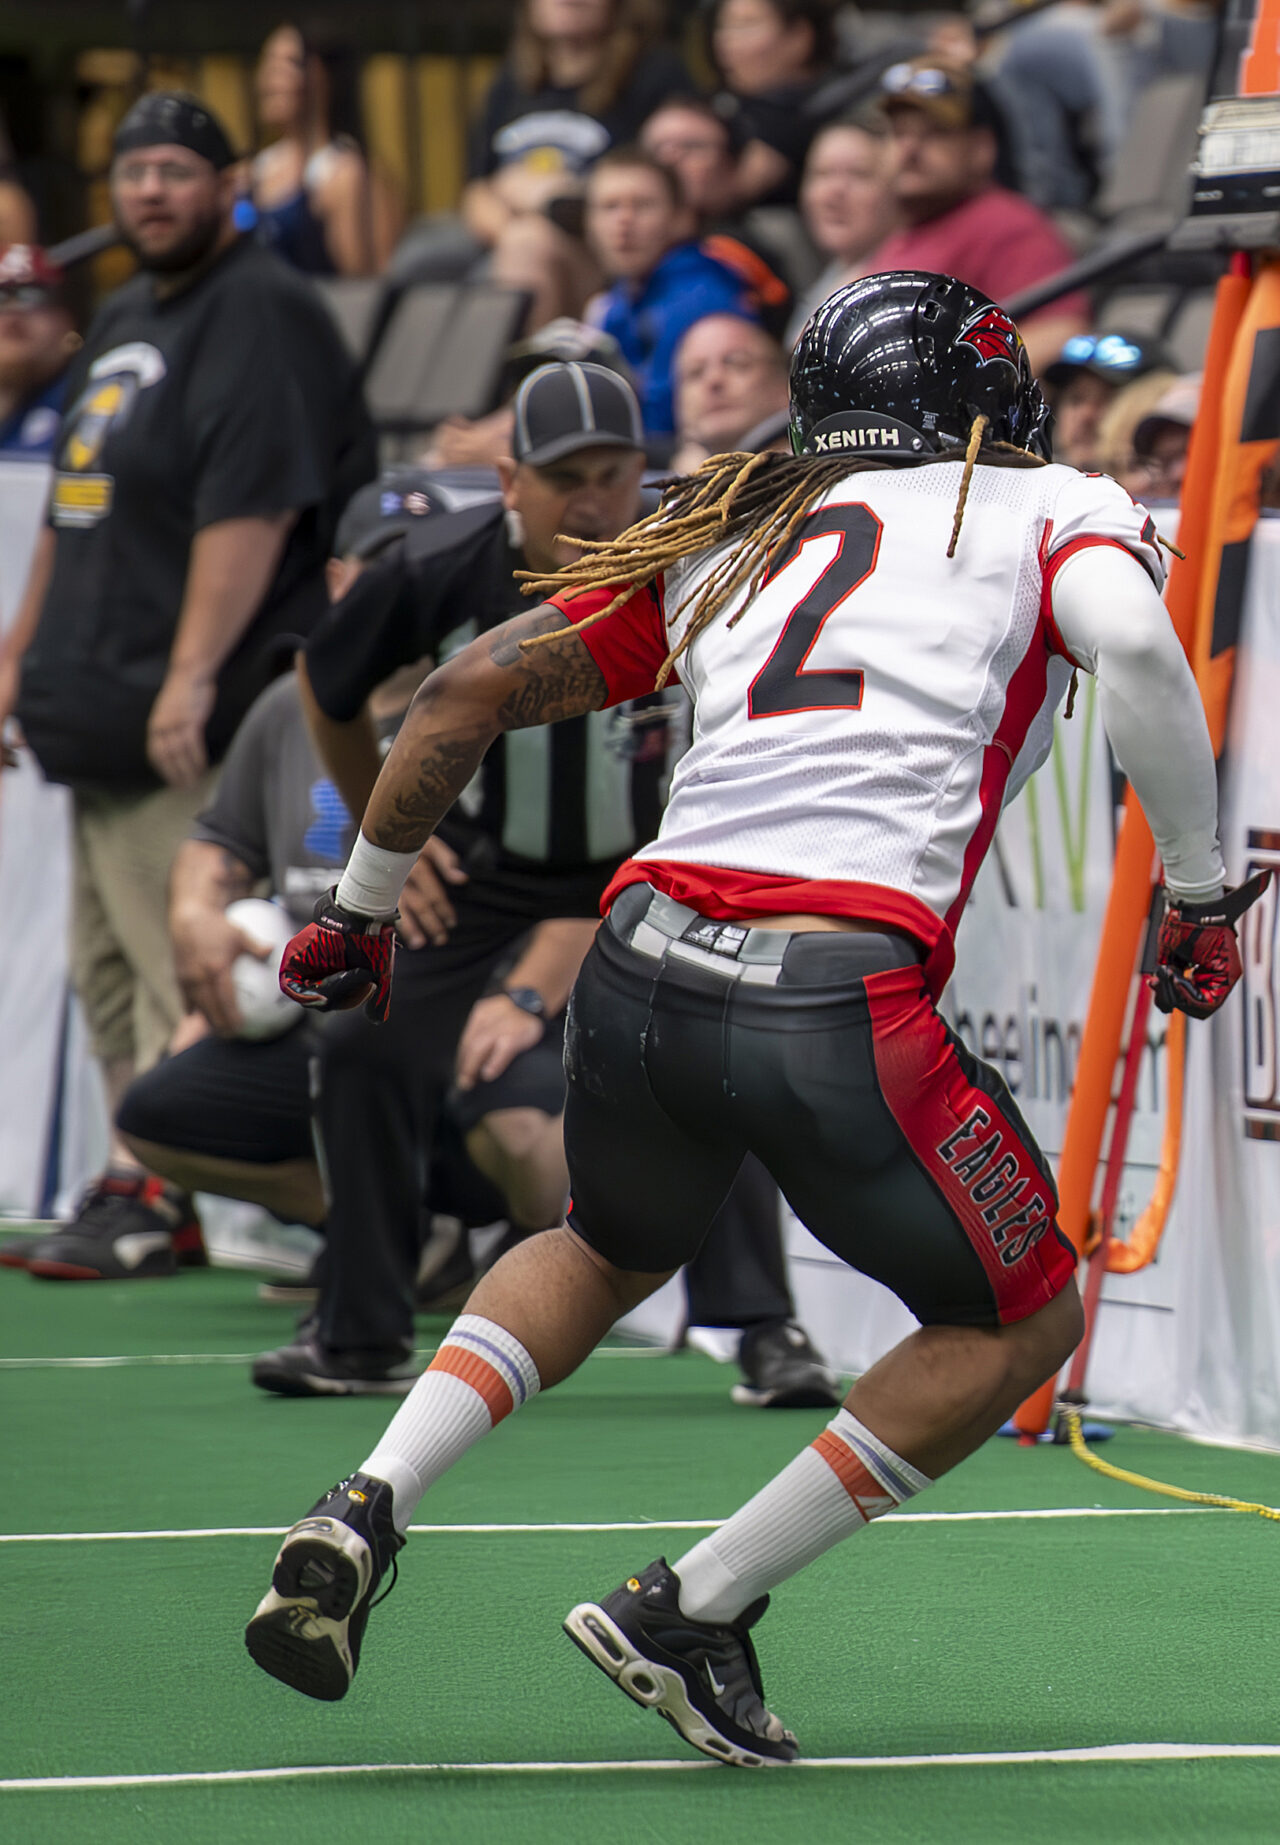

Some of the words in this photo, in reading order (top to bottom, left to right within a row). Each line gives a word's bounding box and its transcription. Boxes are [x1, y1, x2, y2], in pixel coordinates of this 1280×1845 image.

[814, 428, 900, 453] XENITH
[748, 501, 884, 721] 2
[936, 1104, 1050, 1267] EAGLES
